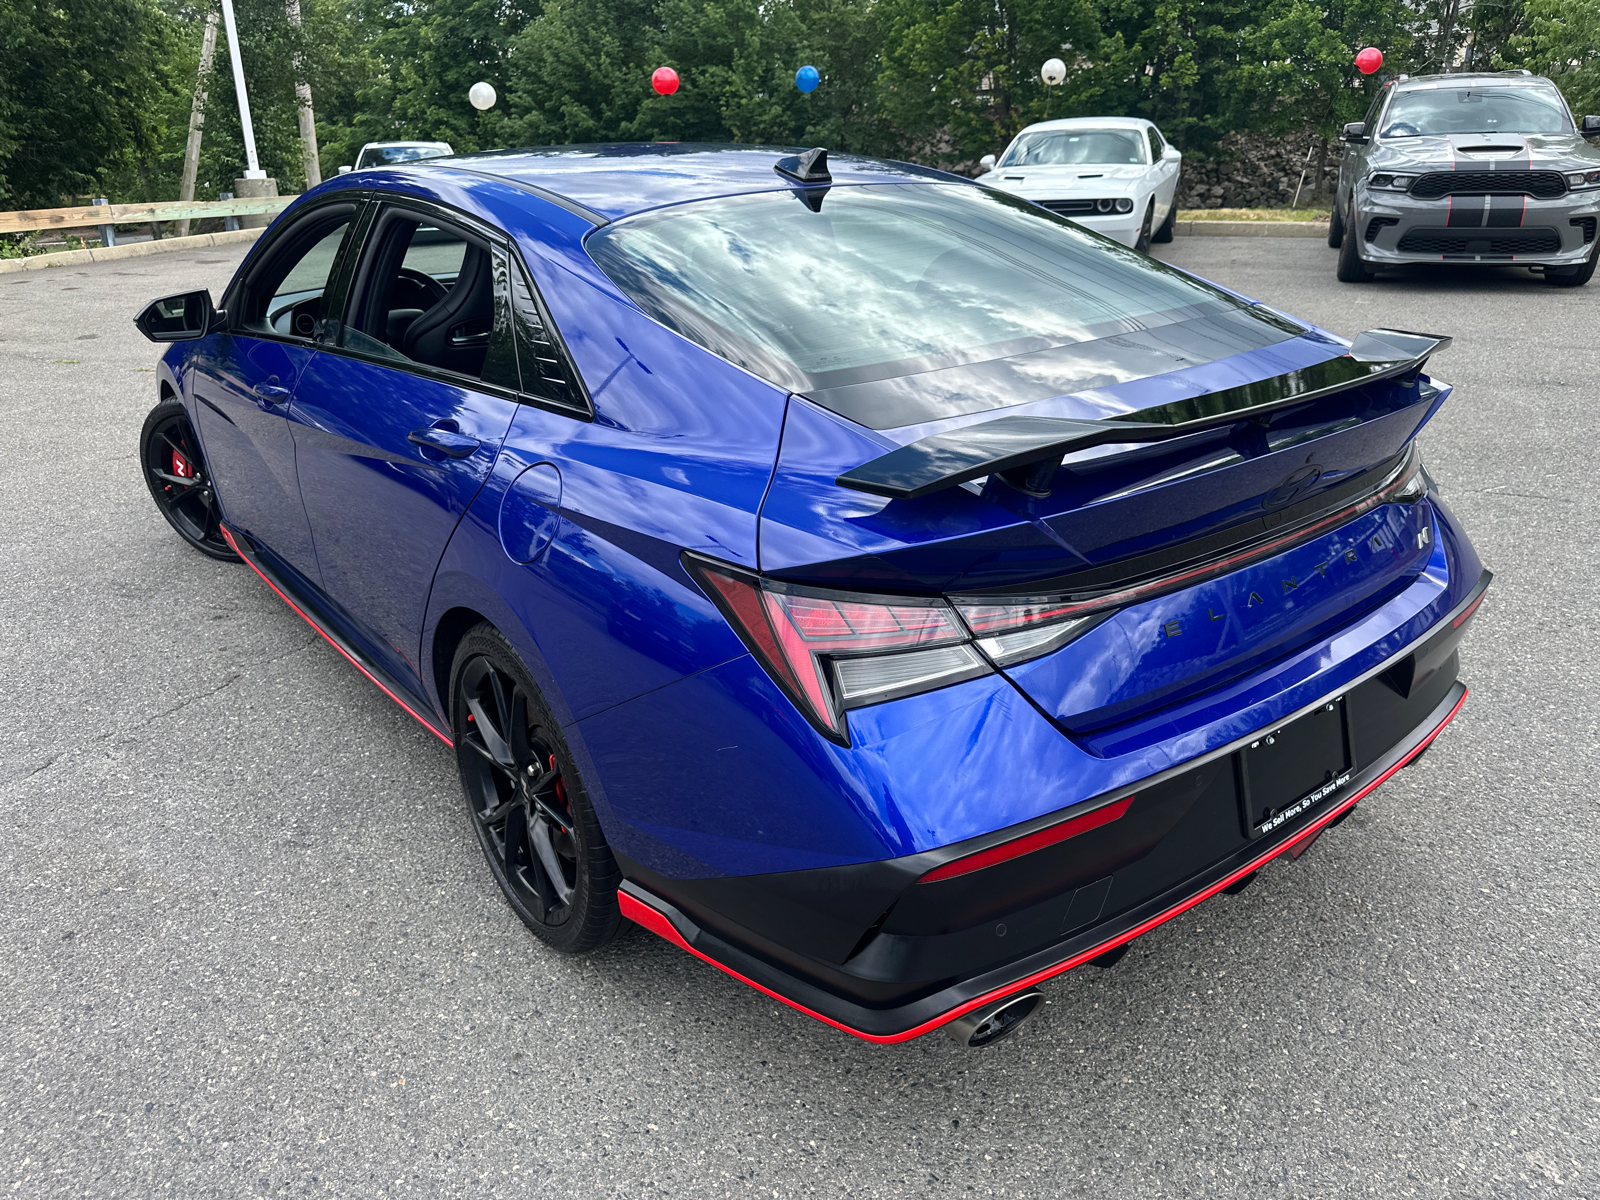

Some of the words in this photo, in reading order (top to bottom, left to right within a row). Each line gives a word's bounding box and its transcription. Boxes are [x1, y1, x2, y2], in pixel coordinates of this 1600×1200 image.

[1417, 525, 1431, 550] N
[1163, 535, 1383, 638] ELANTRA
[1261, 822, 1273, 834] We
[1273, 813, 1285, 827] Sell
[1285, 805, 1302, 820] More,
[1302, 799, 1311, 809] So
[1310, 791, 1322, 803] You
[1322, 783, 1336, 796] Save
[1336, 774, 1350, 787] More
